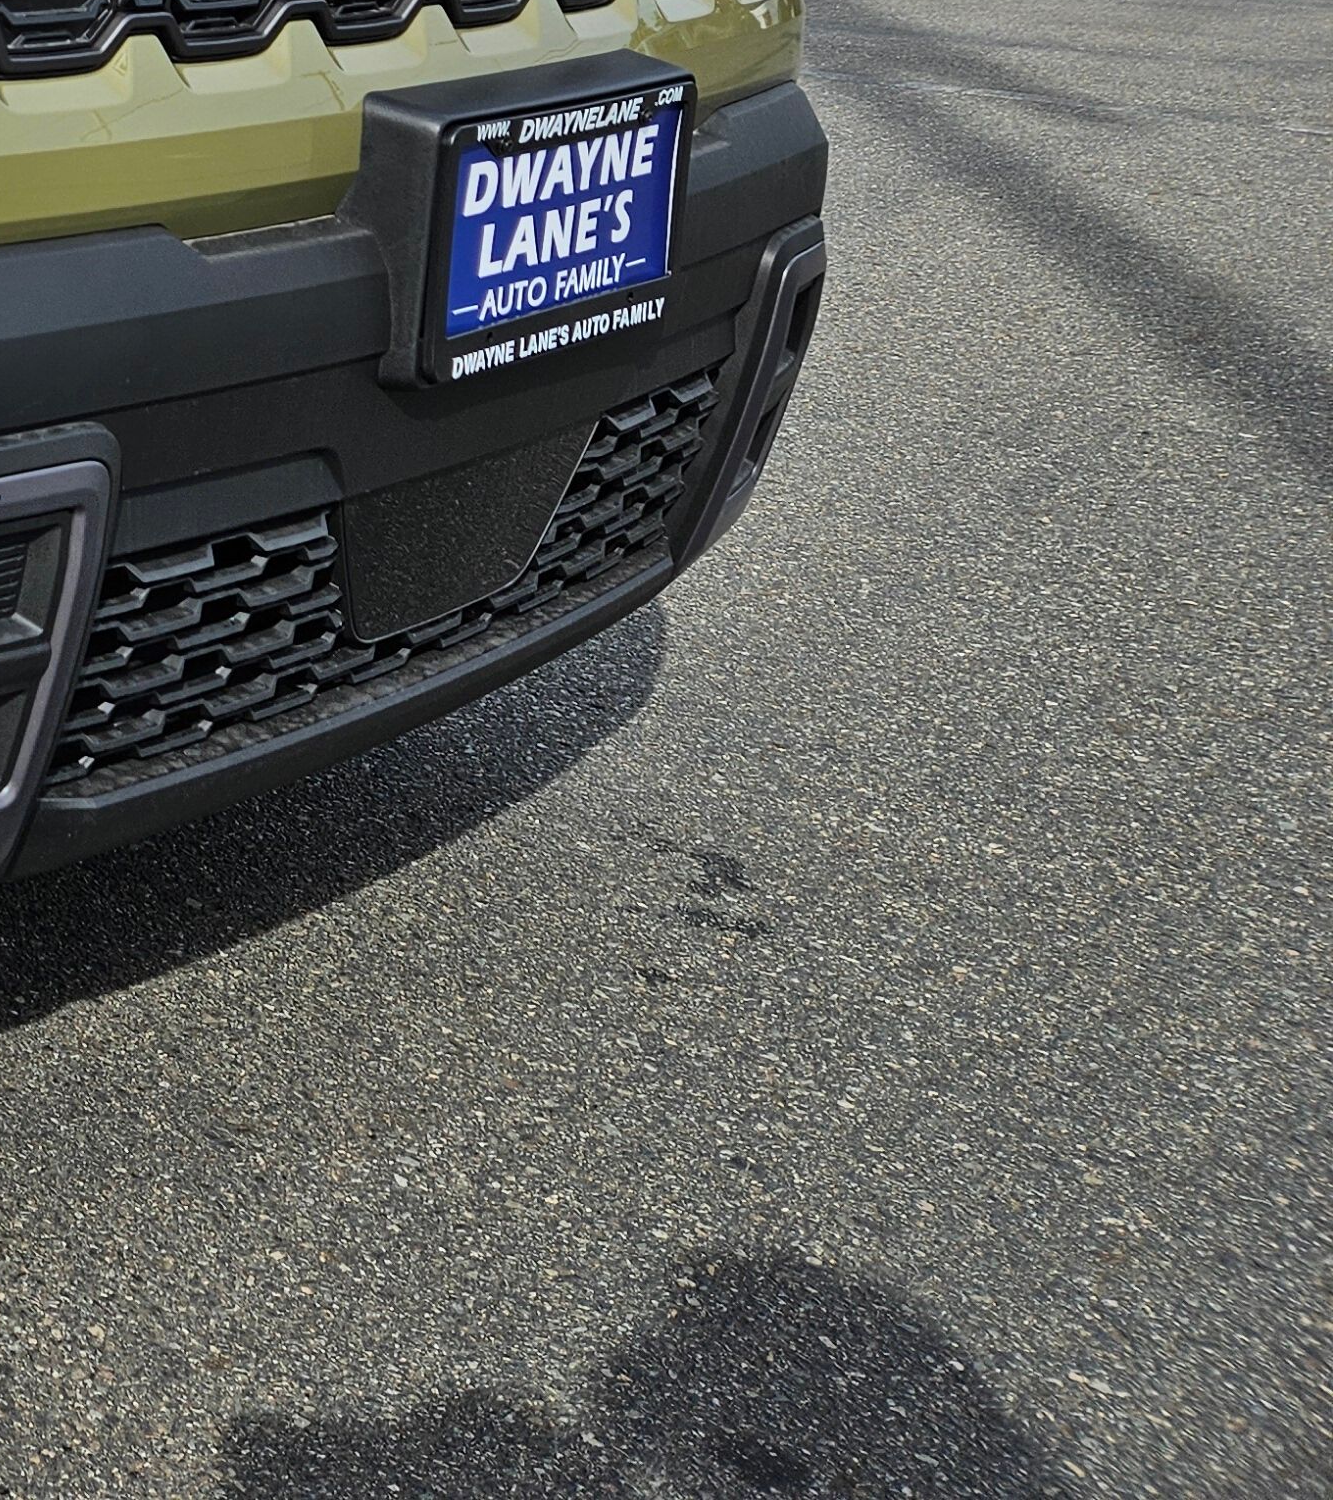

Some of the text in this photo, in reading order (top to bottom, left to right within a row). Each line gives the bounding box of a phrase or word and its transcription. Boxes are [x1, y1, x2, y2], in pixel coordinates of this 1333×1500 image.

[518, 97, 644, 144] DWAYNELANE
[462, 124, 660, 218] DWAYNE
[478, 189, 633, 279] LANE'S
[479, 253, 626, 322] AUTO FAMILY
[451, 297, 665, 380] DWAYNE LANE'S AUTO FAMILY
